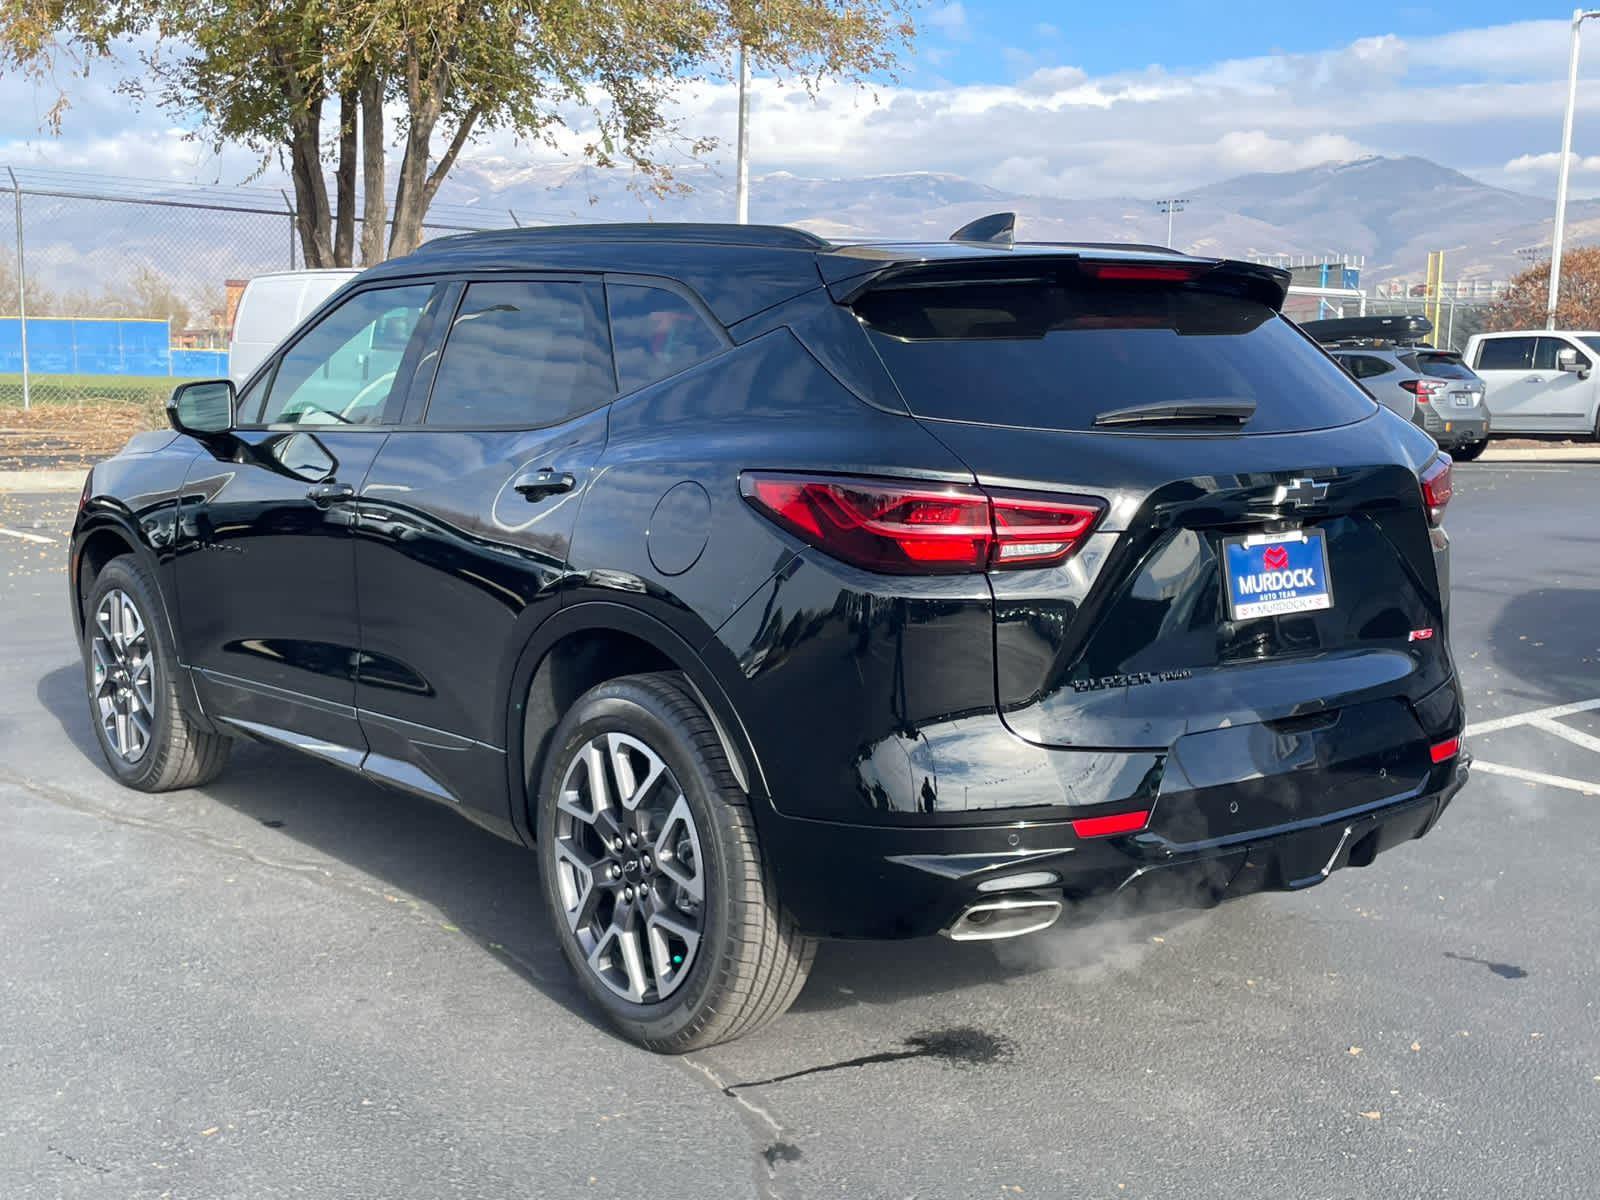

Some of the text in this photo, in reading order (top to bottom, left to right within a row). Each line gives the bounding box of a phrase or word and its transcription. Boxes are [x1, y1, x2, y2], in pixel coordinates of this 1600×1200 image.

[1238, 567, 1316, 595] MURDOCK
[1260, 589, 1297, 601] AUTO TEAM
[1073, 672, 1152, 693] BLAZER
